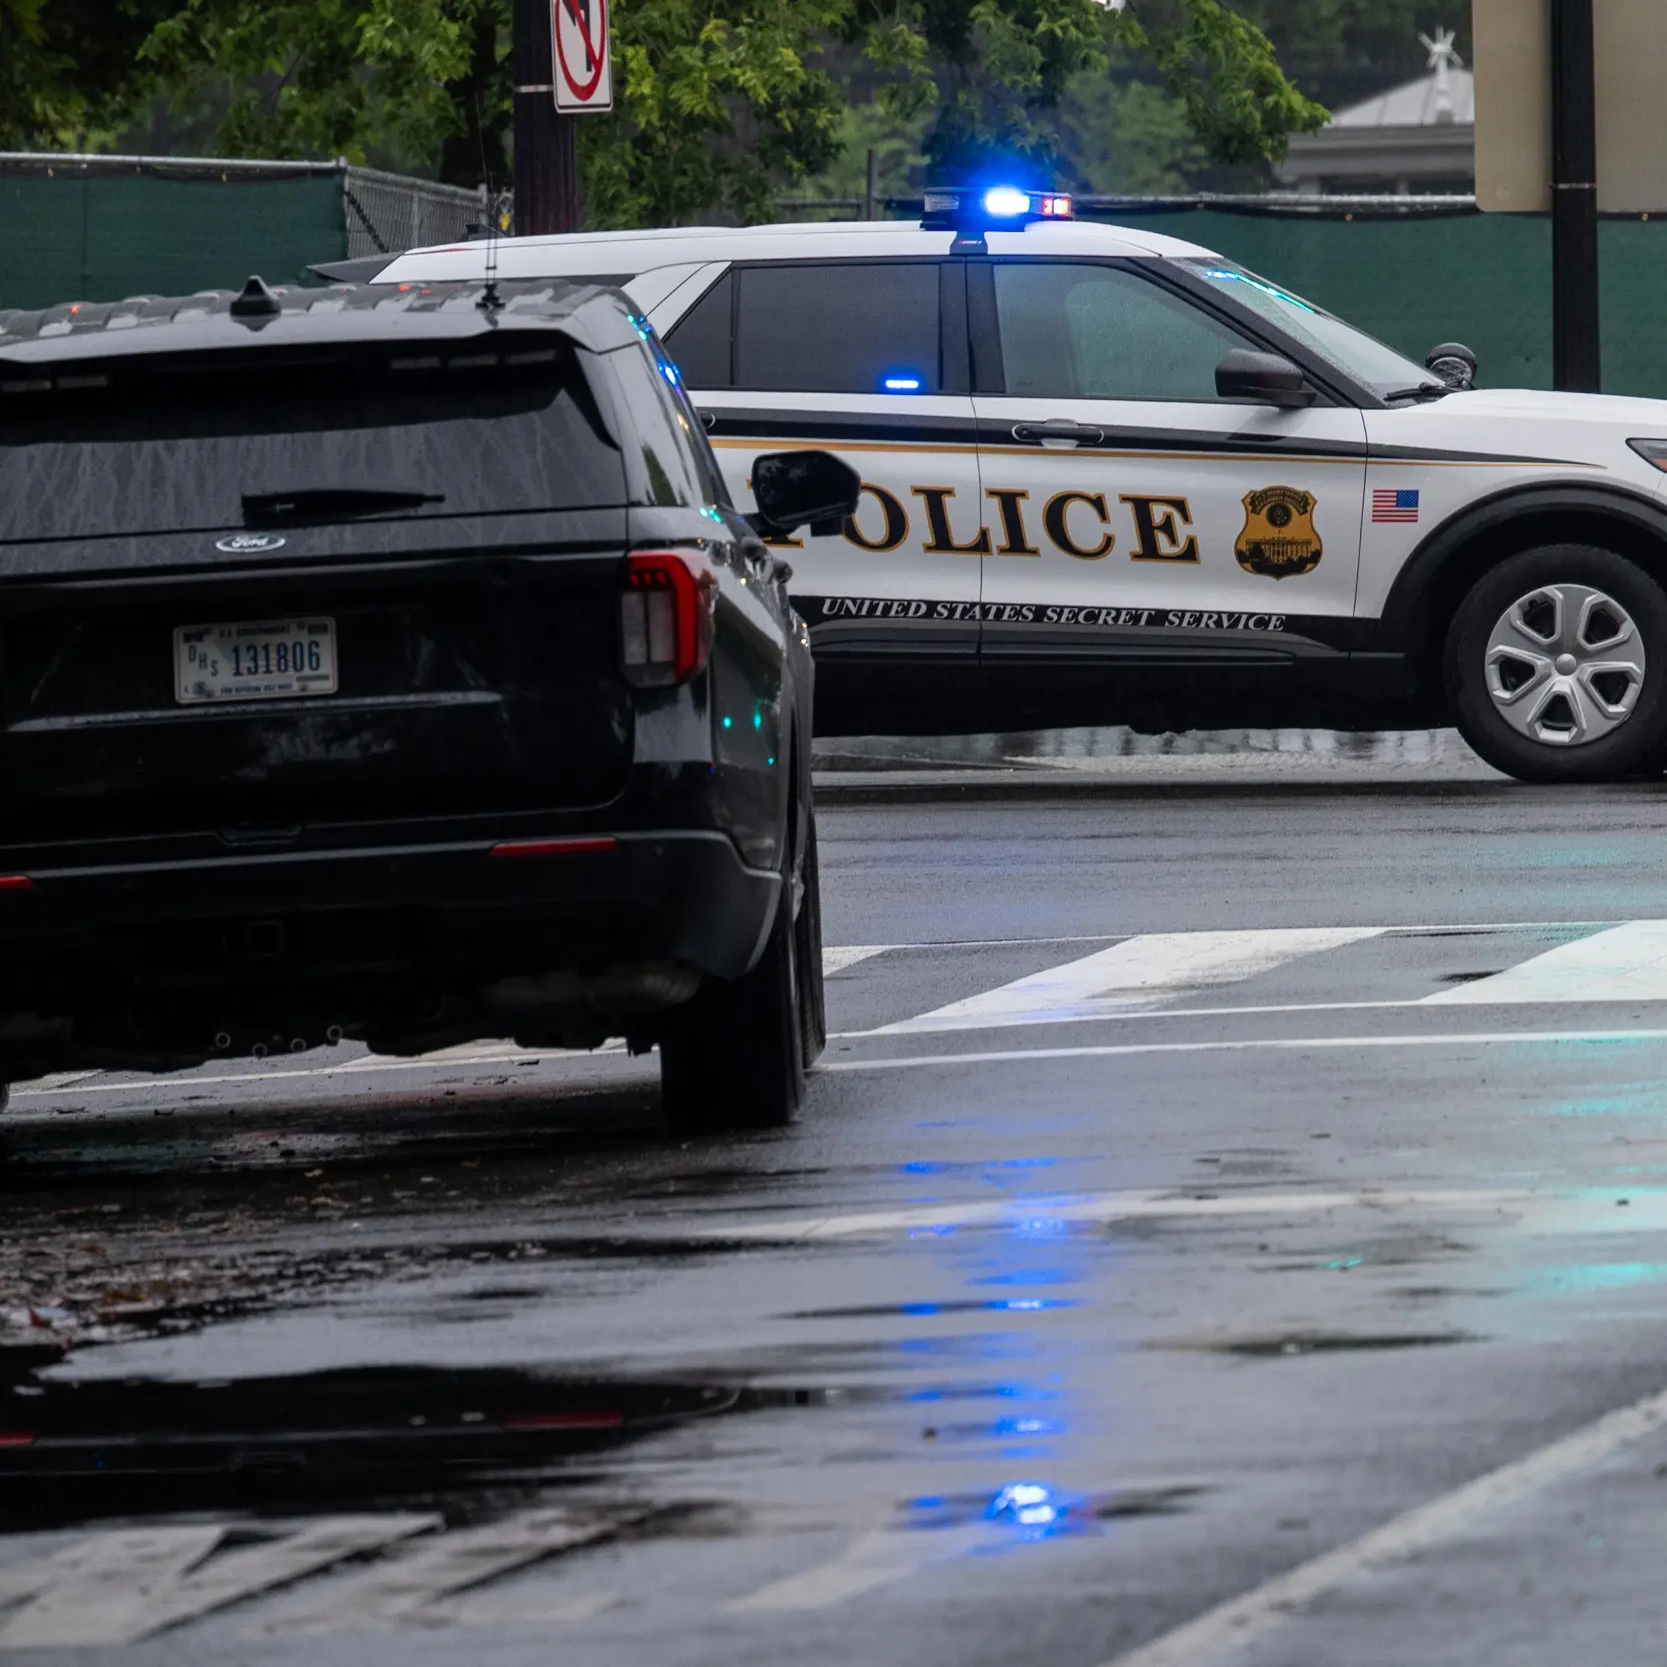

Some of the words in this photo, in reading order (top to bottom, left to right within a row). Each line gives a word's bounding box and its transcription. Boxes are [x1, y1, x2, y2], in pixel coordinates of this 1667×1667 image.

[762, 482, 1201, 564] OLICE
[821, 597, 927, 618] UNITED
[933, 601, 1036, 622] STATES
[1043, 606, 1155, 627] SECRET
[1164, 610, 1287, 632] SERVICE
[231, 640, 321, 677] 131806
